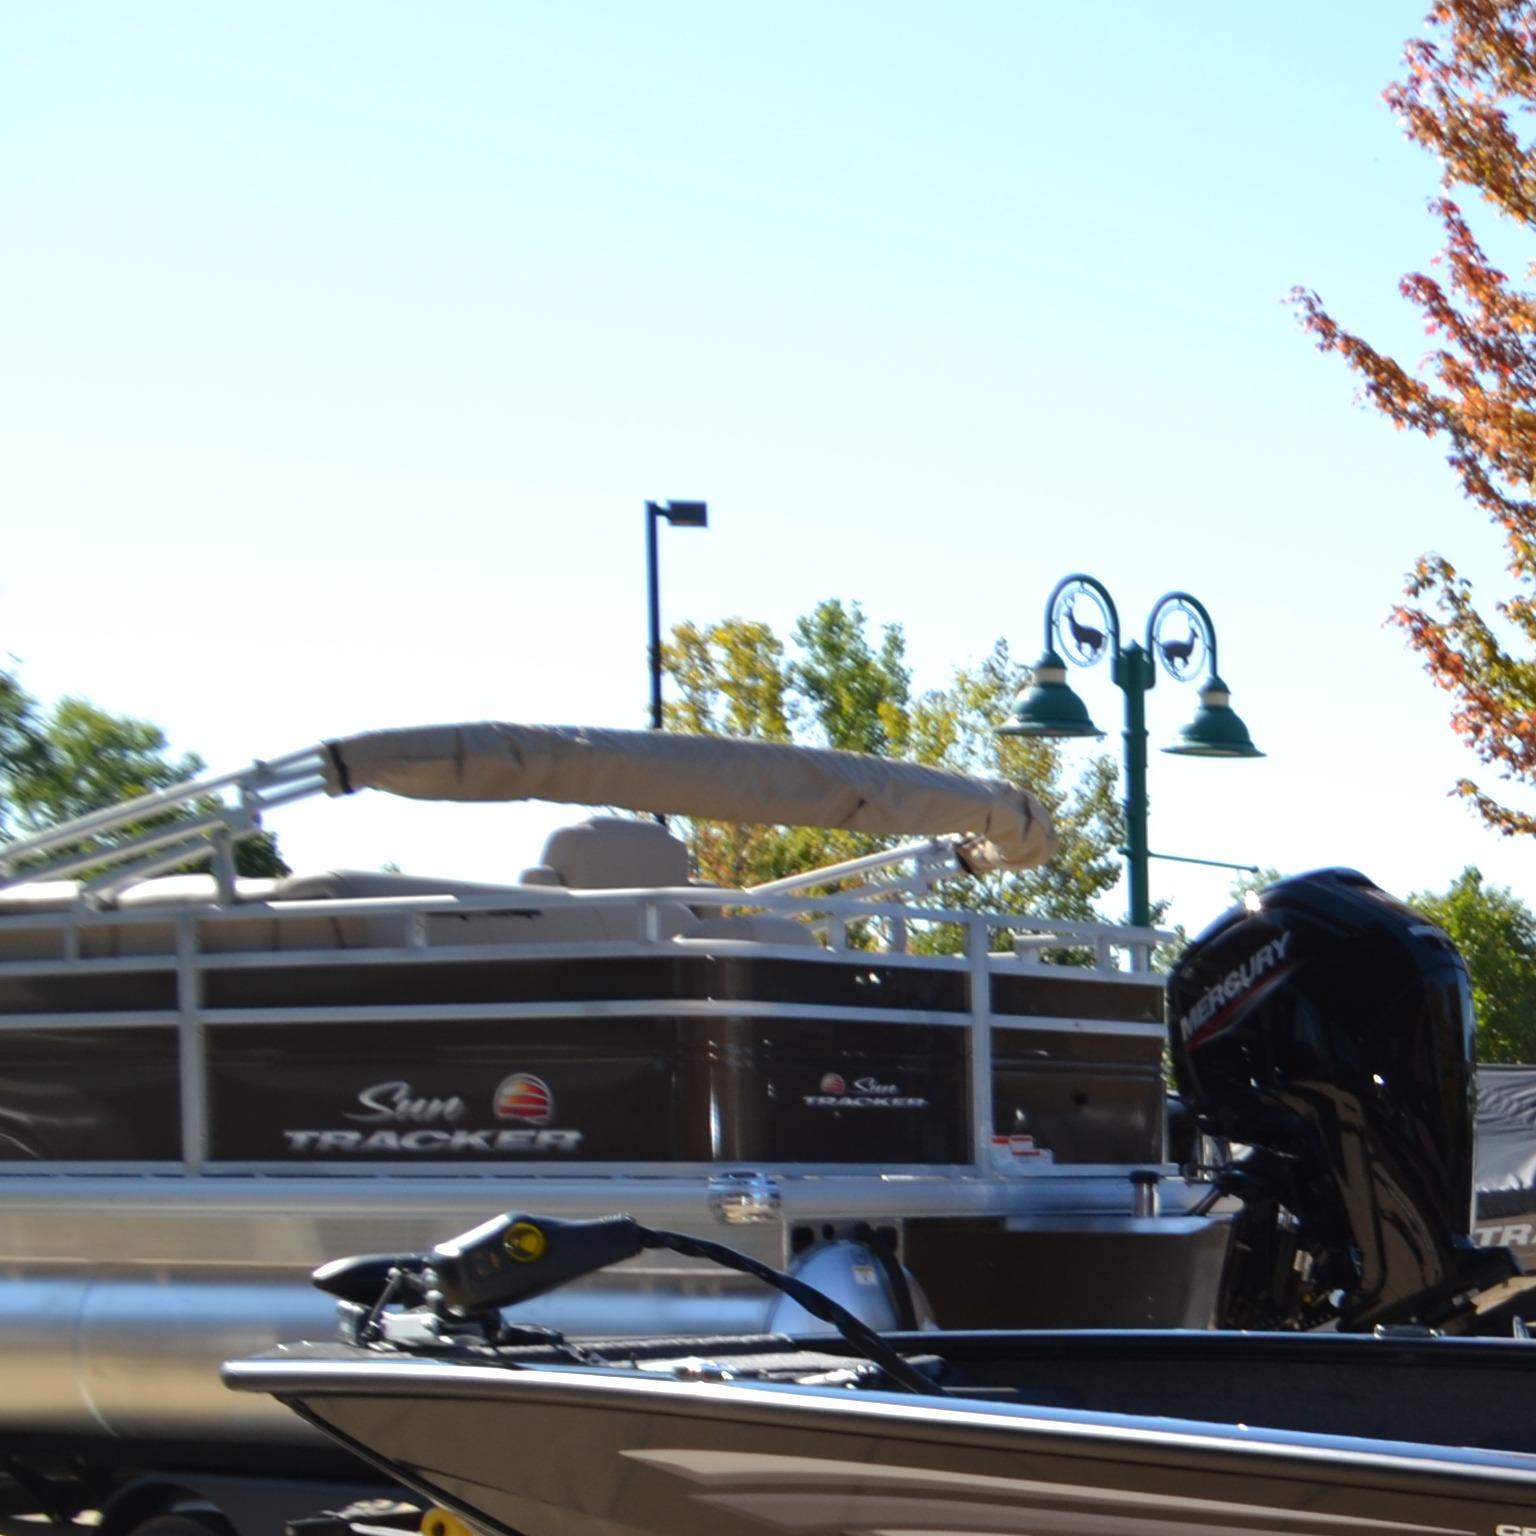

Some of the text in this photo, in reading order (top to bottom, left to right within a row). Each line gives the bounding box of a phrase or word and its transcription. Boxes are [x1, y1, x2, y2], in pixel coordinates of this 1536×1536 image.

[1179, 929, 1294, 1041] MERCURY
[341, 1080, 465, 1124] Sun
[801, 1096, 928, 1108] TRACKER
[282, 1129, 585, 1151] TRACKER
